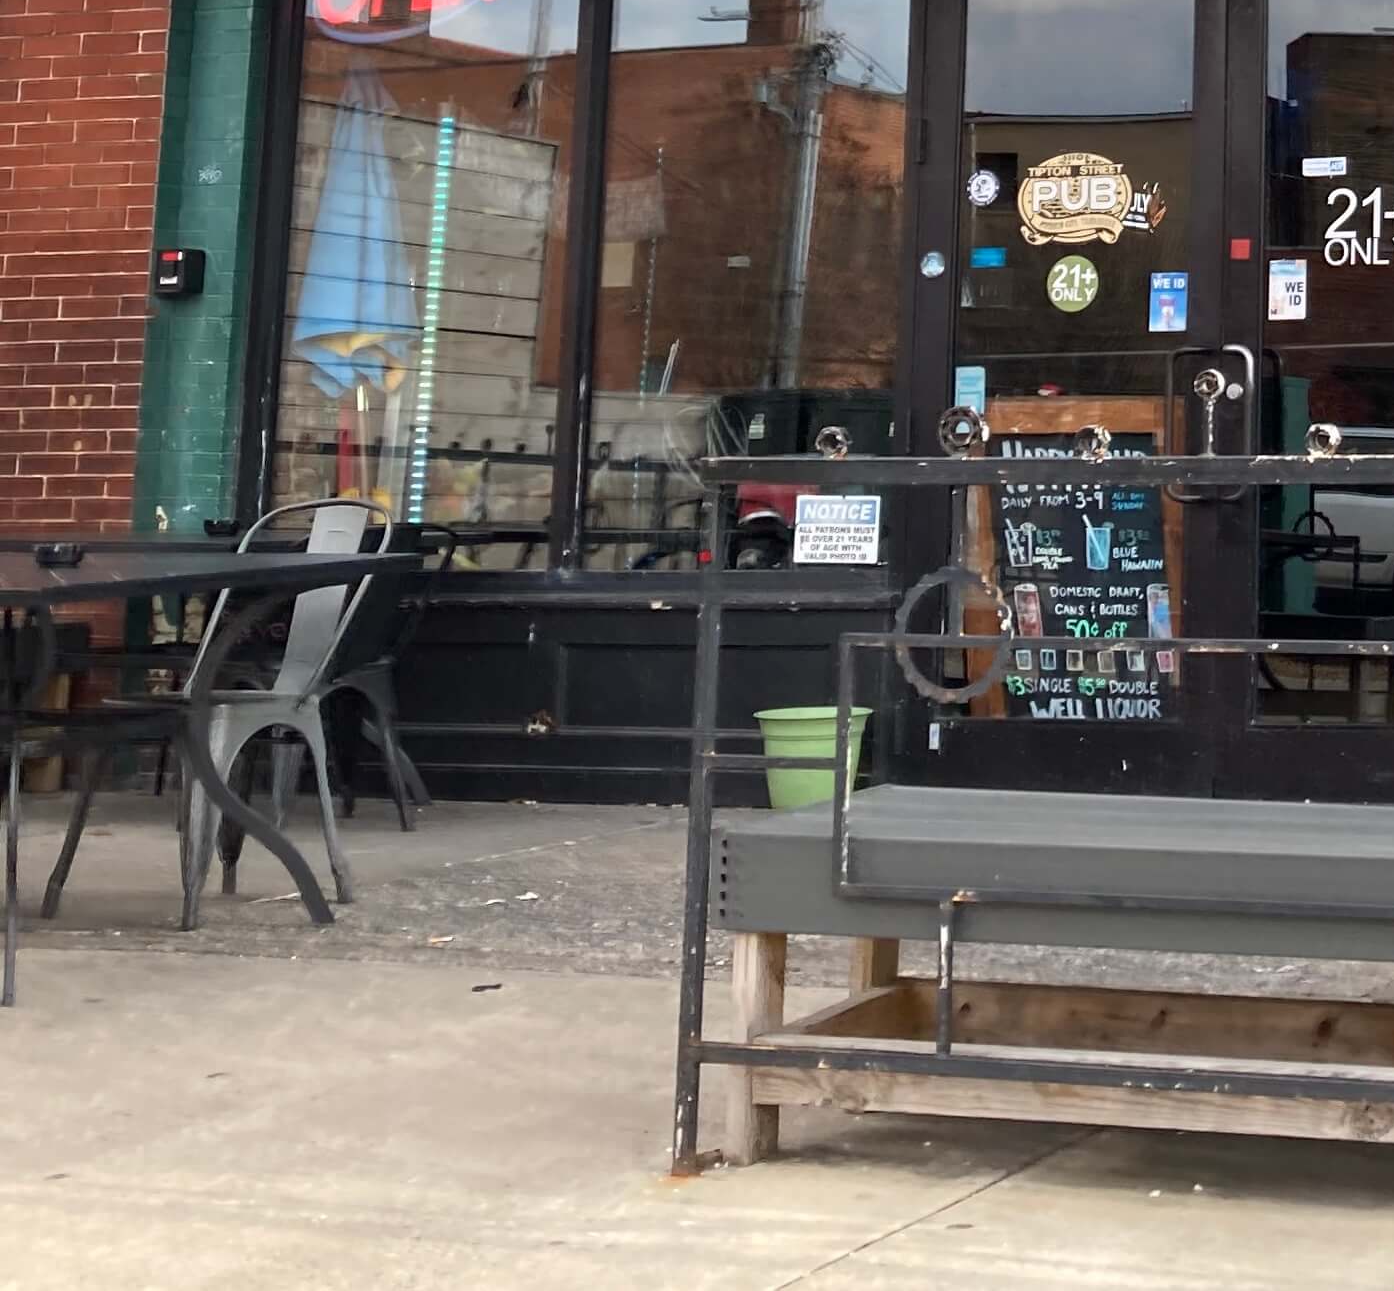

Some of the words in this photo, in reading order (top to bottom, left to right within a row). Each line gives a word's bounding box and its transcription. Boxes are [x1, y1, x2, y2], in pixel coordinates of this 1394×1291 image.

[1027, 166, 1072, 177] TIPTON
[1079, 164, 1124, 176] STREET
[1033, 177, 1117, 213] PUB
[1053, 264, 1097, 288] 21+
[1153, 277, 1171, 289] WE
[1173, 277, 1185, 289] ID
[1285, 281, 1305, 293] WE
[1051, 287, 1096, 303] ONLY
[1289, 295, 1302, 306] ID
[1001, 496, 1033, 510] DAILY
[1040, 494, 1070, 507] FROM
[1075, 491, 1103, 510] 3-9
[803, 503, 873, 521] NOTICE
[799, 526, 812, 534] ALL
[815, 526, 851, 534] PATRONS
[853, 526, 875, 534] MUST
[800, 535, 810, 543] BE
[812, 535, 833, 543] OVER
[835, 535, 845, 543] 21
[847, 535, 874, 543] YEARS
[1112, 546, 1139, 559] BLUE
[1049, 585, 1101, 598] DOMESTIC
[1054, 603, 1085, 615] CANS
[1099, 603, 1139, 615] BOTTLES
[1103, 621, 1128, 638] off
[1024, 677, 1073, 693] SINGLE
[1108, 679, 1159, 695] DOUBLE
[1029, 697, 1085, 720] WELL
[1095, 697, 1163, 720] LIQUOR
